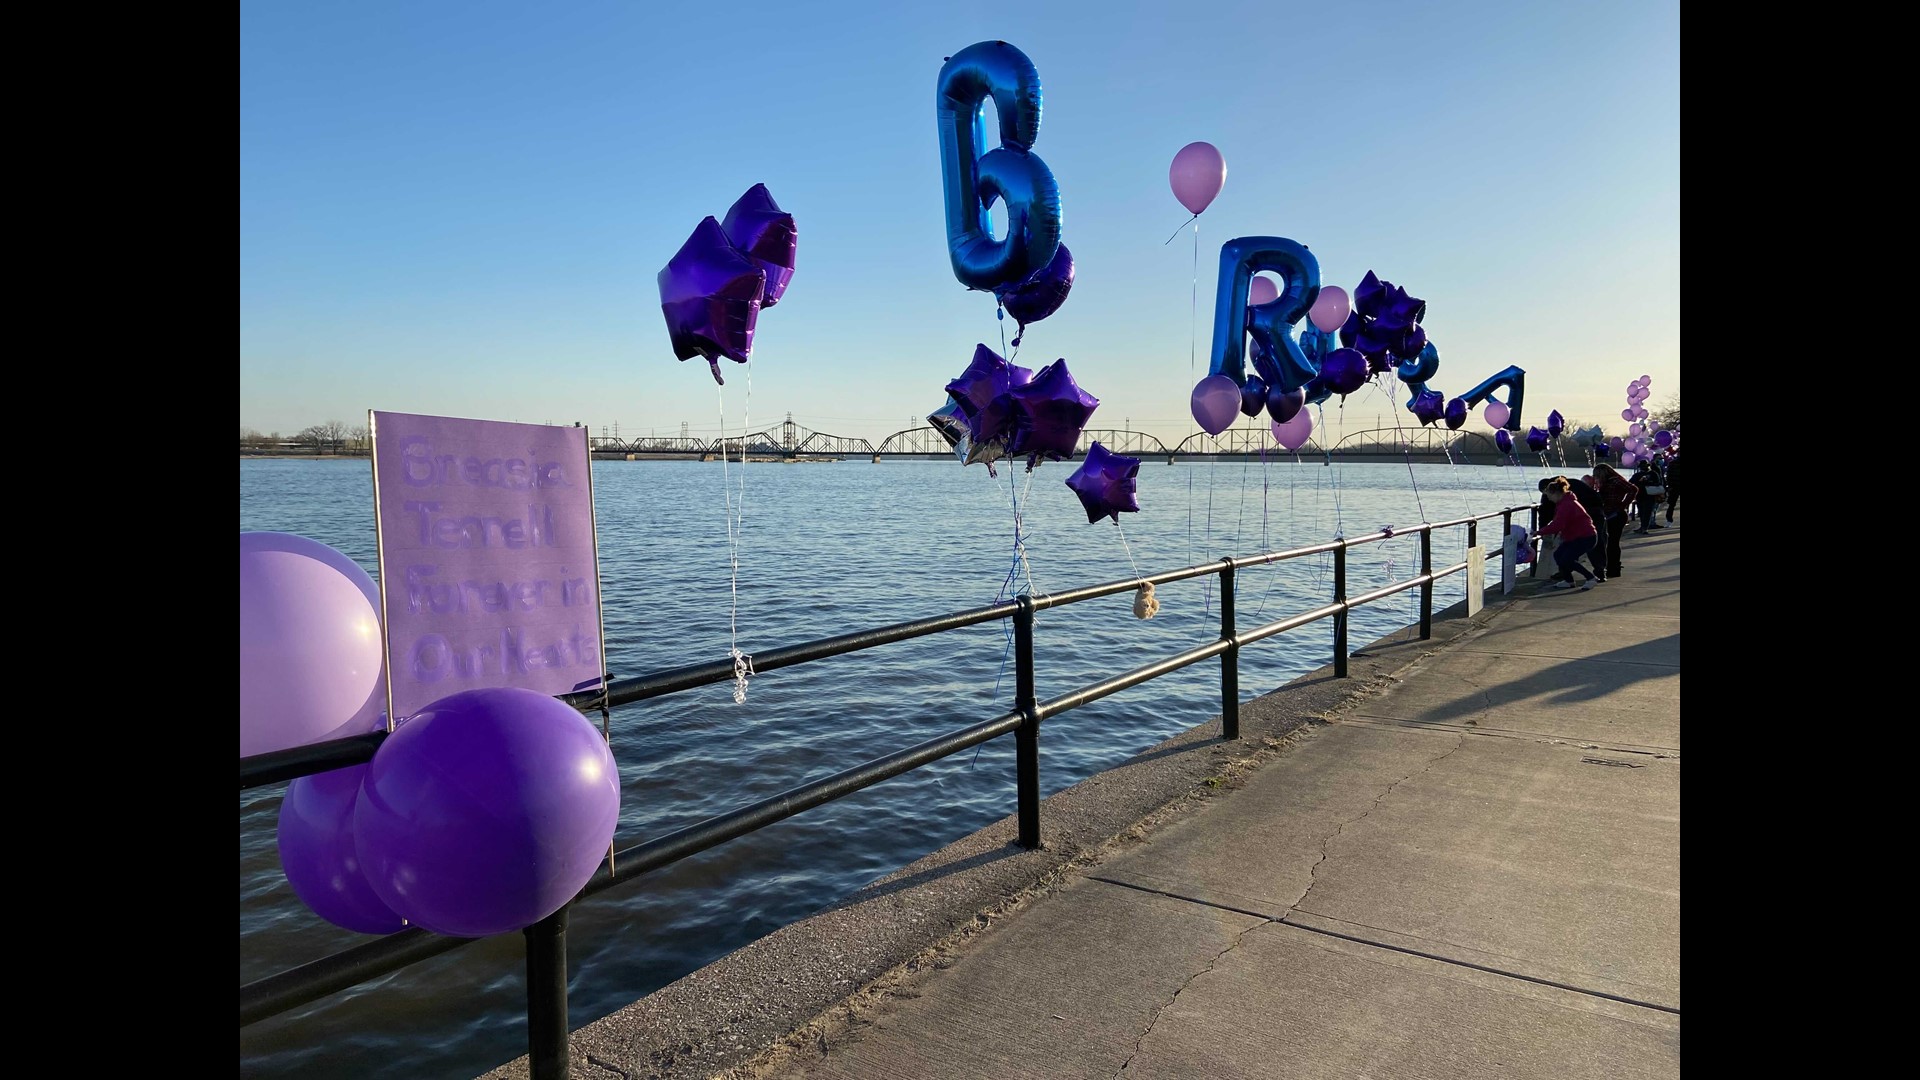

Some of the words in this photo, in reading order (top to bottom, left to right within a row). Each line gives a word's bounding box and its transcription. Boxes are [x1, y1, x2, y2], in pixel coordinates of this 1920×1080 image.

[404, 499, 555, 549] Terrell
[406, 563, 549, 615] Forever
[560, 566, 591, 608] in
[409, 632, 495, 683] Our
